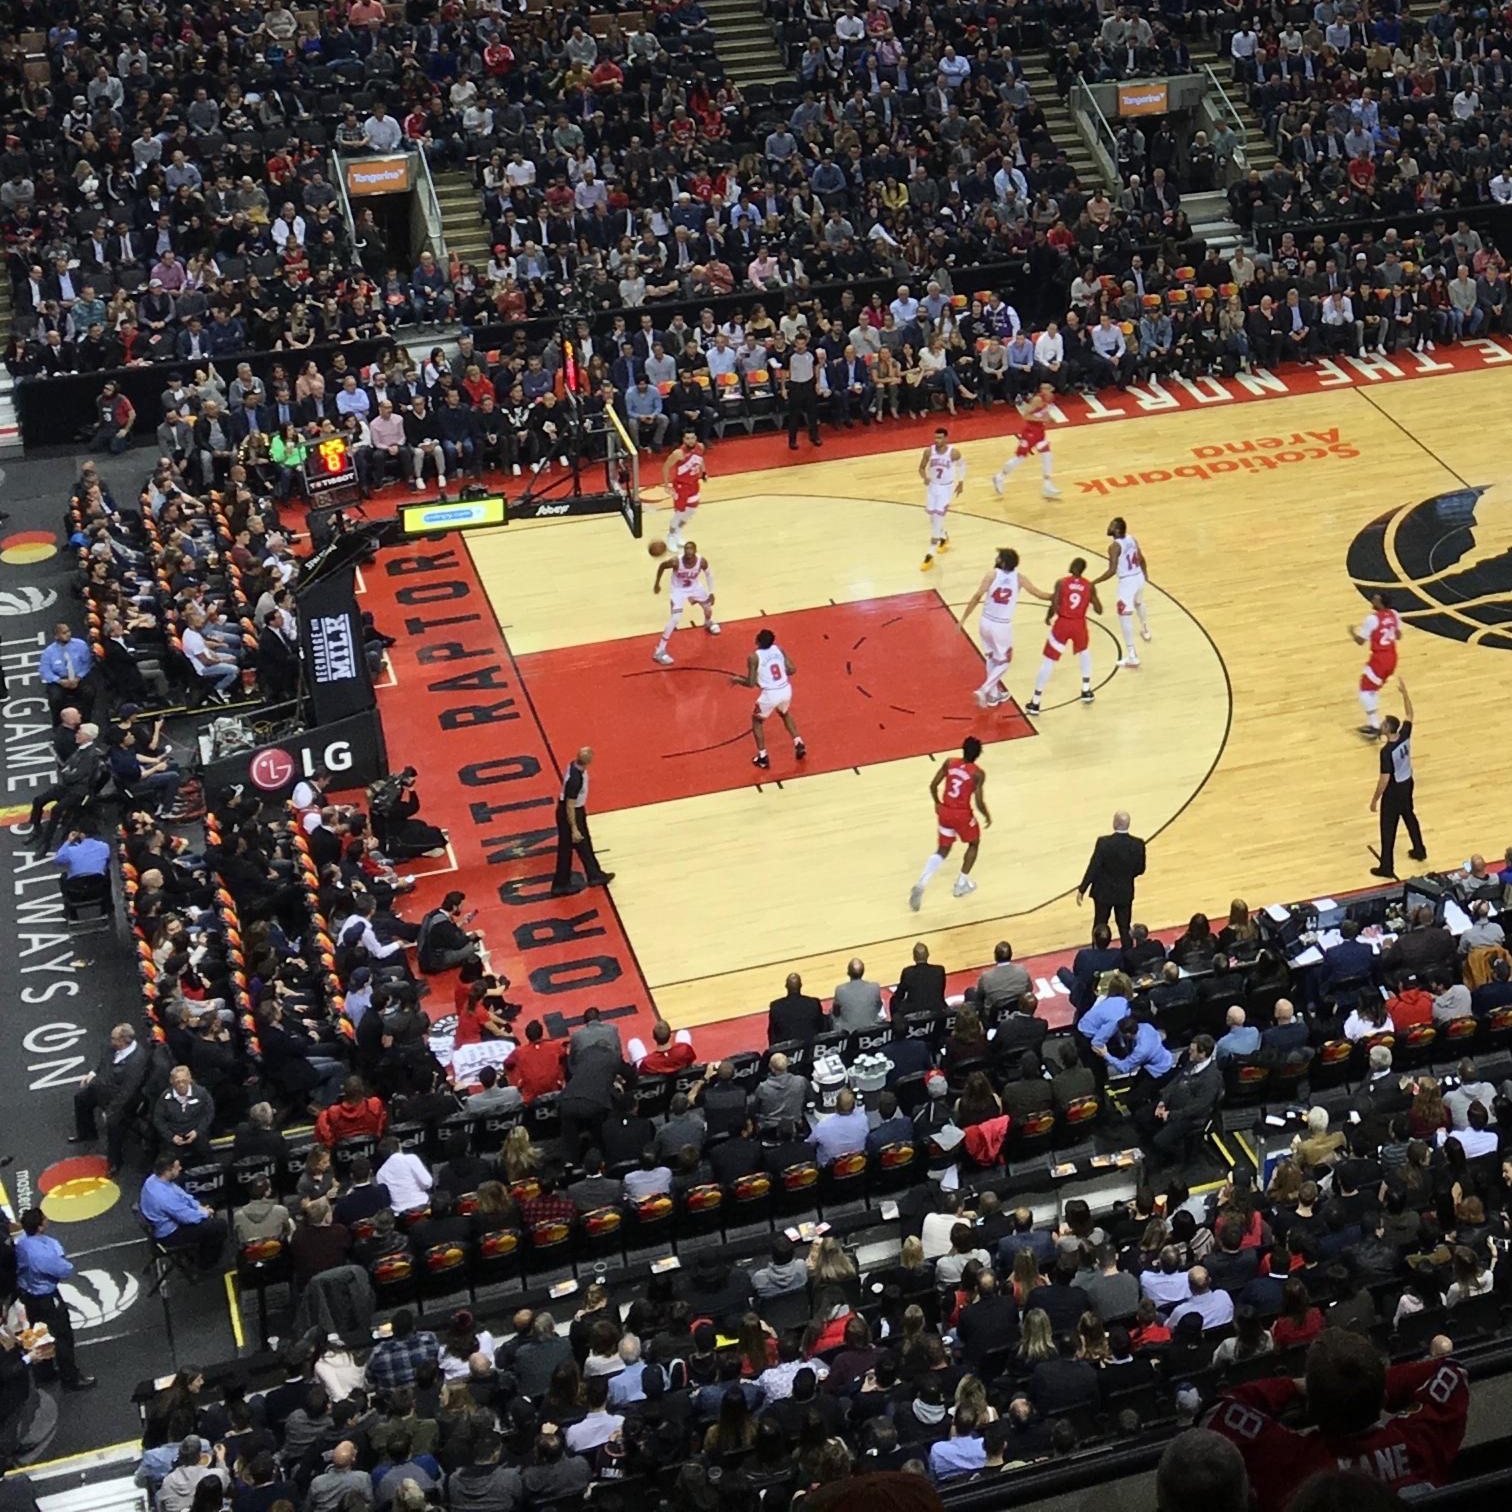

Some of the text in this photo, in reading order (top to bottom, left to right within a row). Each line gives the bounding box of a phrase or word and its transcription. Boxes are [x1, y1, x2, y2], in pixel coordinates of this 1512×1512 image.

[1315, 347, 1454, 387] THE
[1190, 427, 1341, 459] Arena
[1075, 442, 1361, 496] Scotiabank
[991, 586, 1012, 605] 42
[1068, 592, 1081, 610] 9
[324, 614, 352, 681] MILK
[384, 534, 521, 731] RAPTOR
[2, 697, 59, 793] GAME
[948, 778, 963, 798] 3
[13, 850, 80, 1004] ALWAYS
[858, 1028, 893, 1051] Bell
[337, 1143, 375, 1162] Bell
[185, 1174, 224, 1193] Bell
[237, 1162, 276, 1184] Bell
[1430, 1366, 1459, 1404] 8
[1224, 1402, 1263, 1438] 8
